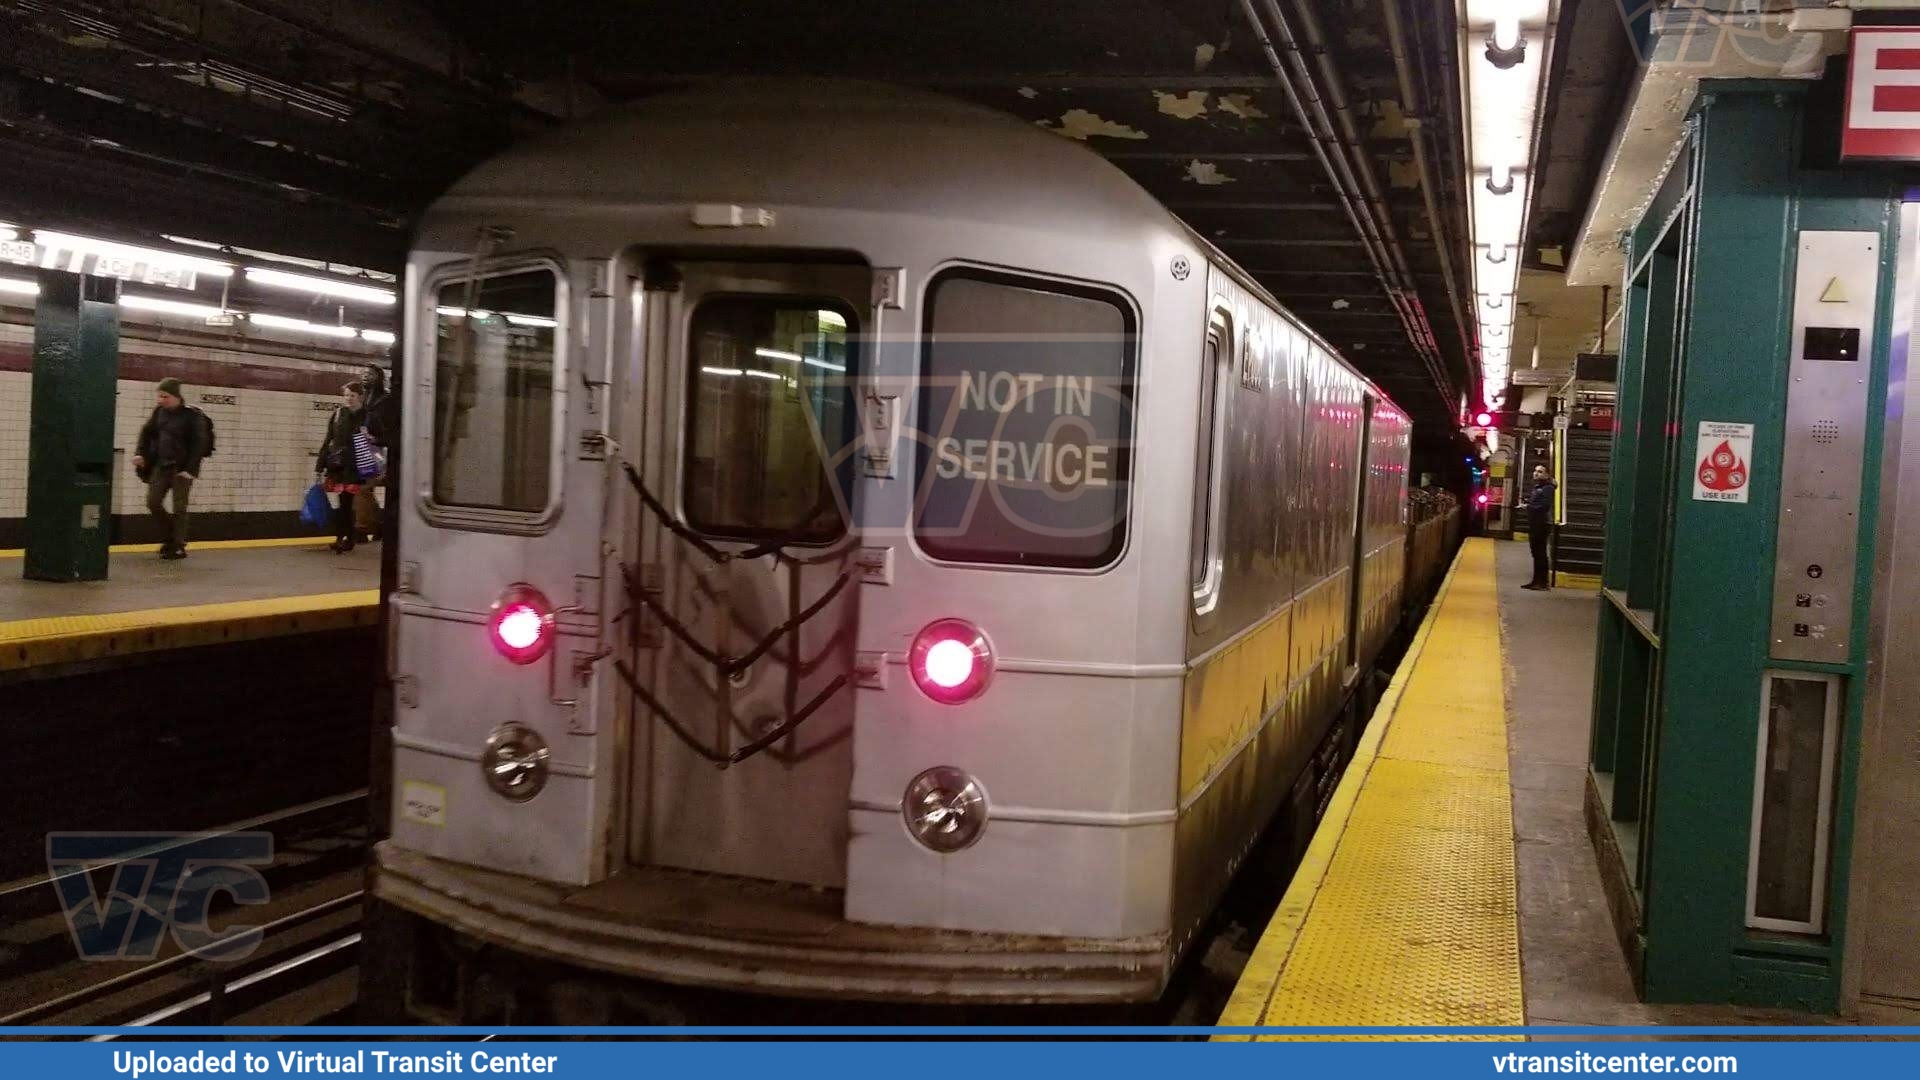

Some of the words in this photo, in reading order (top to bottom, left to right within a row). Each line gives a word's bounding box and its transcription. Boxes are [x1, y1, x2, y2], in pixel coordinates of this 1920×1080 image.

[0, 243, 32, 259] R-46
[959, 369, 1043, 415] NOT
[1054, 374, 1093, 417] IN
[1590, 406, 1613, 417] Exit
[936, 437, 1109, 487] SERVICE
[1702, 491, 1719, 499] USE
[1721, 492, 1739, 500] EXIT
